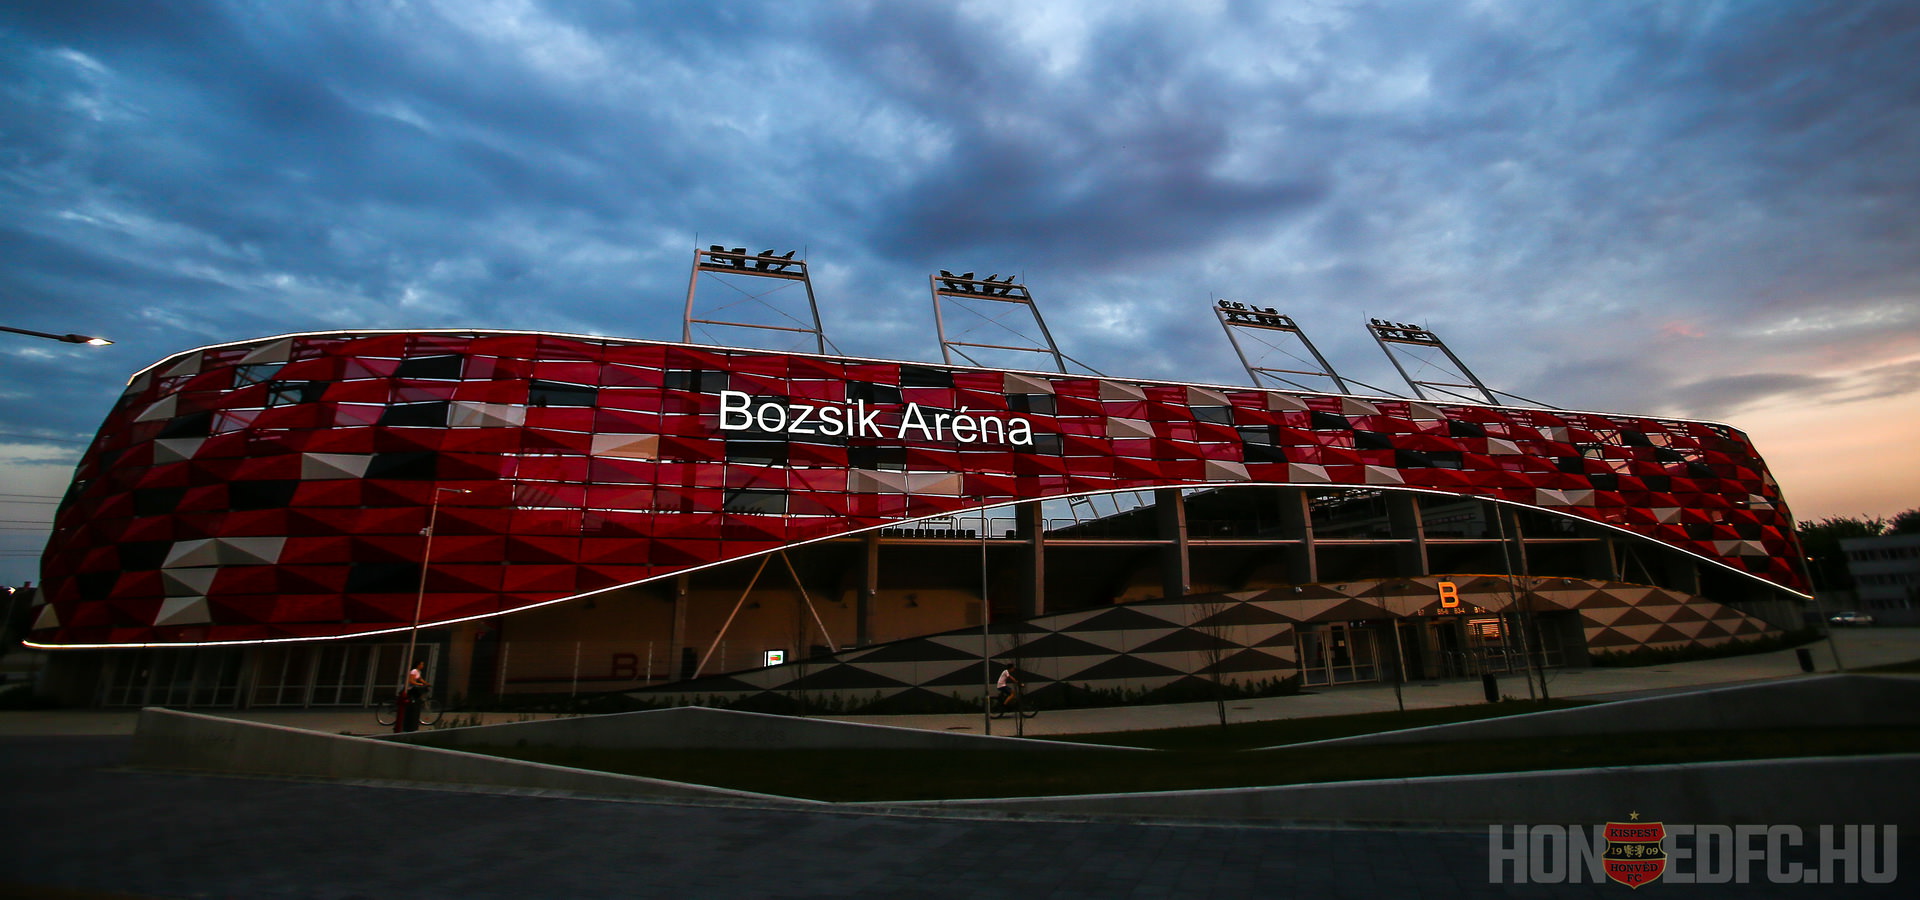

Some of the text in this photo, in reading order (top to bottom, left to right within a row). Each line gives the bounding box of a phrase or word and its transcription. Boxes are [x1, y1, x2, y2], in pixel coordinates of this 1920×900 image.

[719, 390, 1034, 446] Bozsik Aréna
[1438, 581, 1459, 608] B
